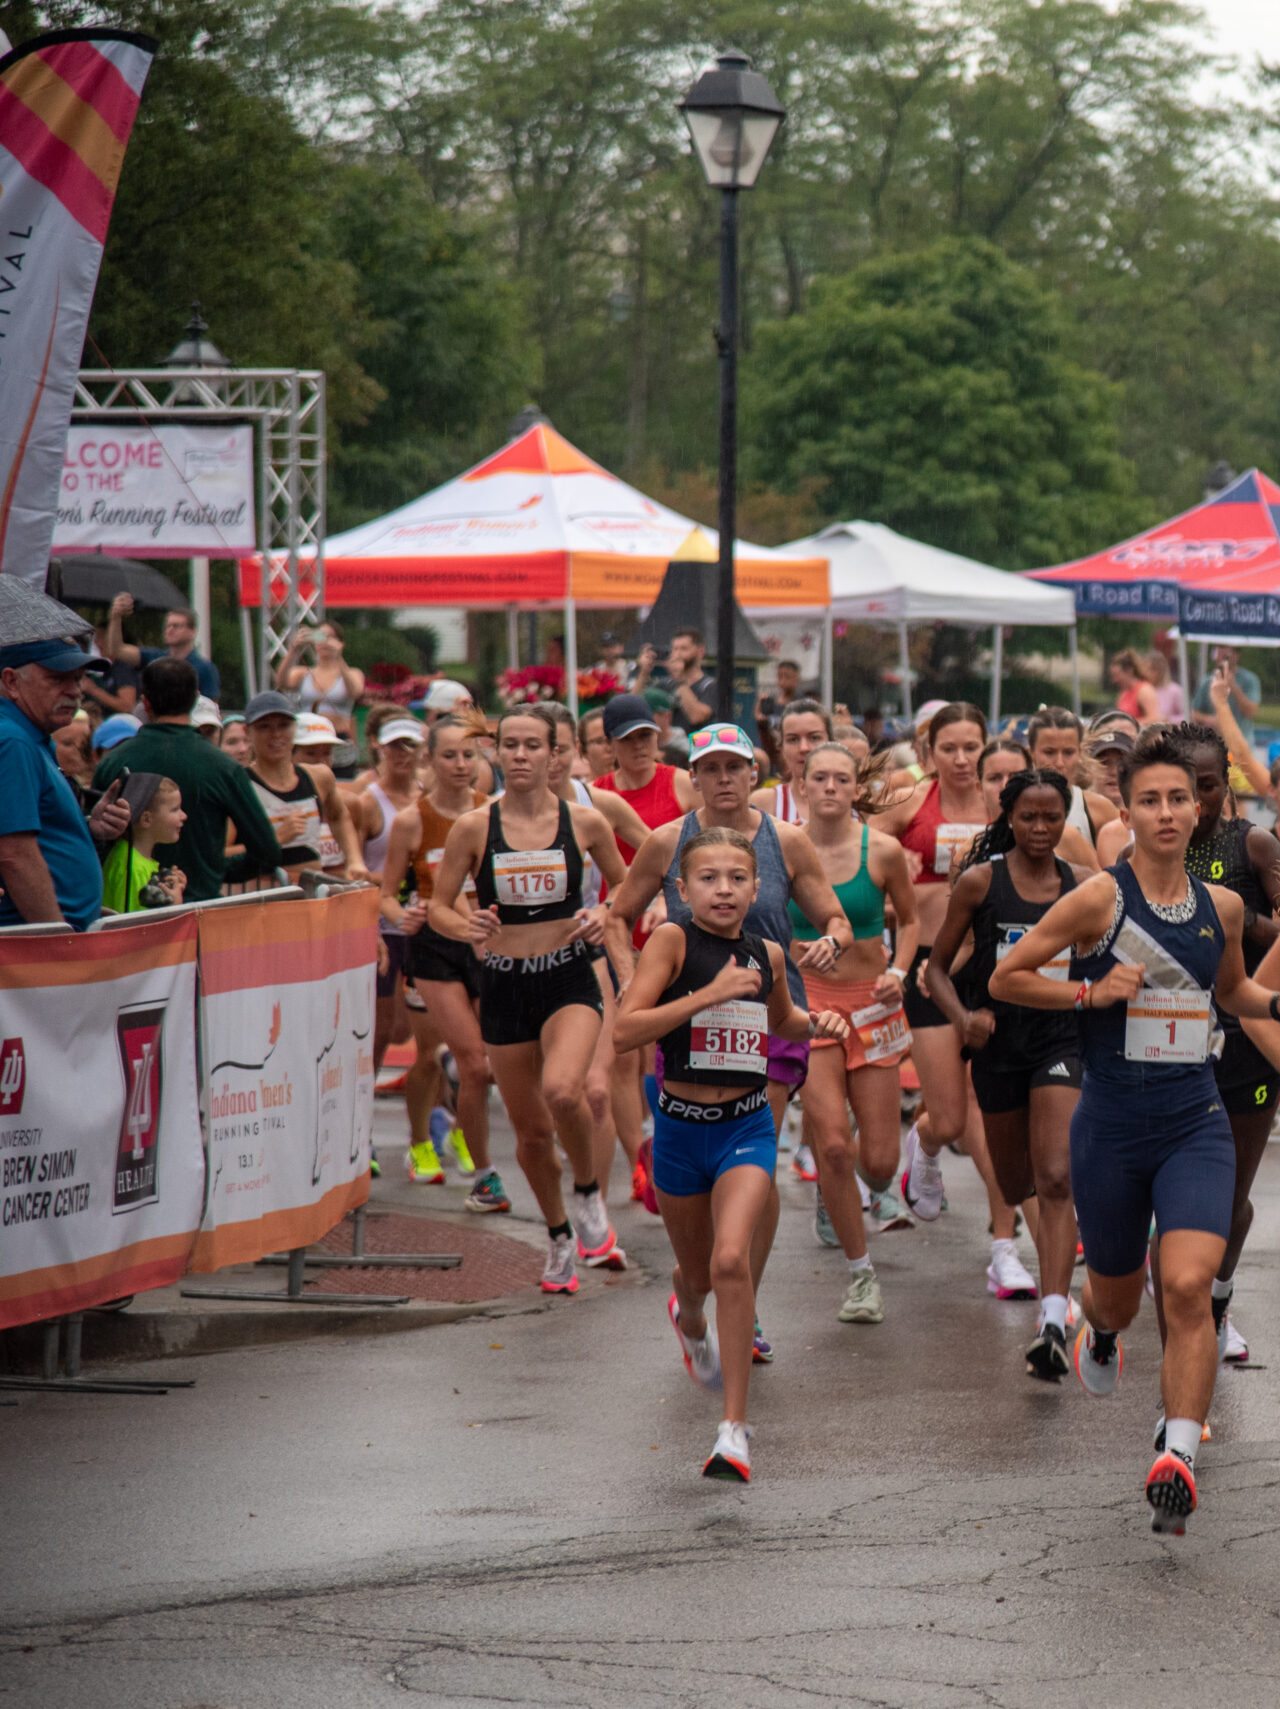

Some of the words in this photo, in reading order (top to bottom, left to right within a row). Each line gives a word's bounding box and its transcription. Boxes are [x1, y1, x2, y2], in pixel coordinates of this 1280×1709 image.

[87, 473, 124, 491] THE
[89, 499, 168, 537] Running
[174, 499, 247, 527] Festival
[1091, 583, 1143, 604] Road
[1184, 597, 1229, 622] Carmel
[1231, 599, 1264, 624] Road
[507, 873, 556, 894] 1176
[484, 950, 514, 972] PRO
[522, 945, 574, 975] NIKE
[705, 1028, 760, 1055] 5182
[1165, 1020, 1176, 1045] 1
[211, 1083, 257, 1119] Indiana
[667, 1100, 723, 1120] PRO
[0, 1127, 43, 1149] NIVERSITY
[3, 1154, 37, 1188] BREN
[38, 1149, 77, 1183] SIMON
[3, 1191, 52, 1227] CANCER
[54, 1182, 91, 1218] CENTER
